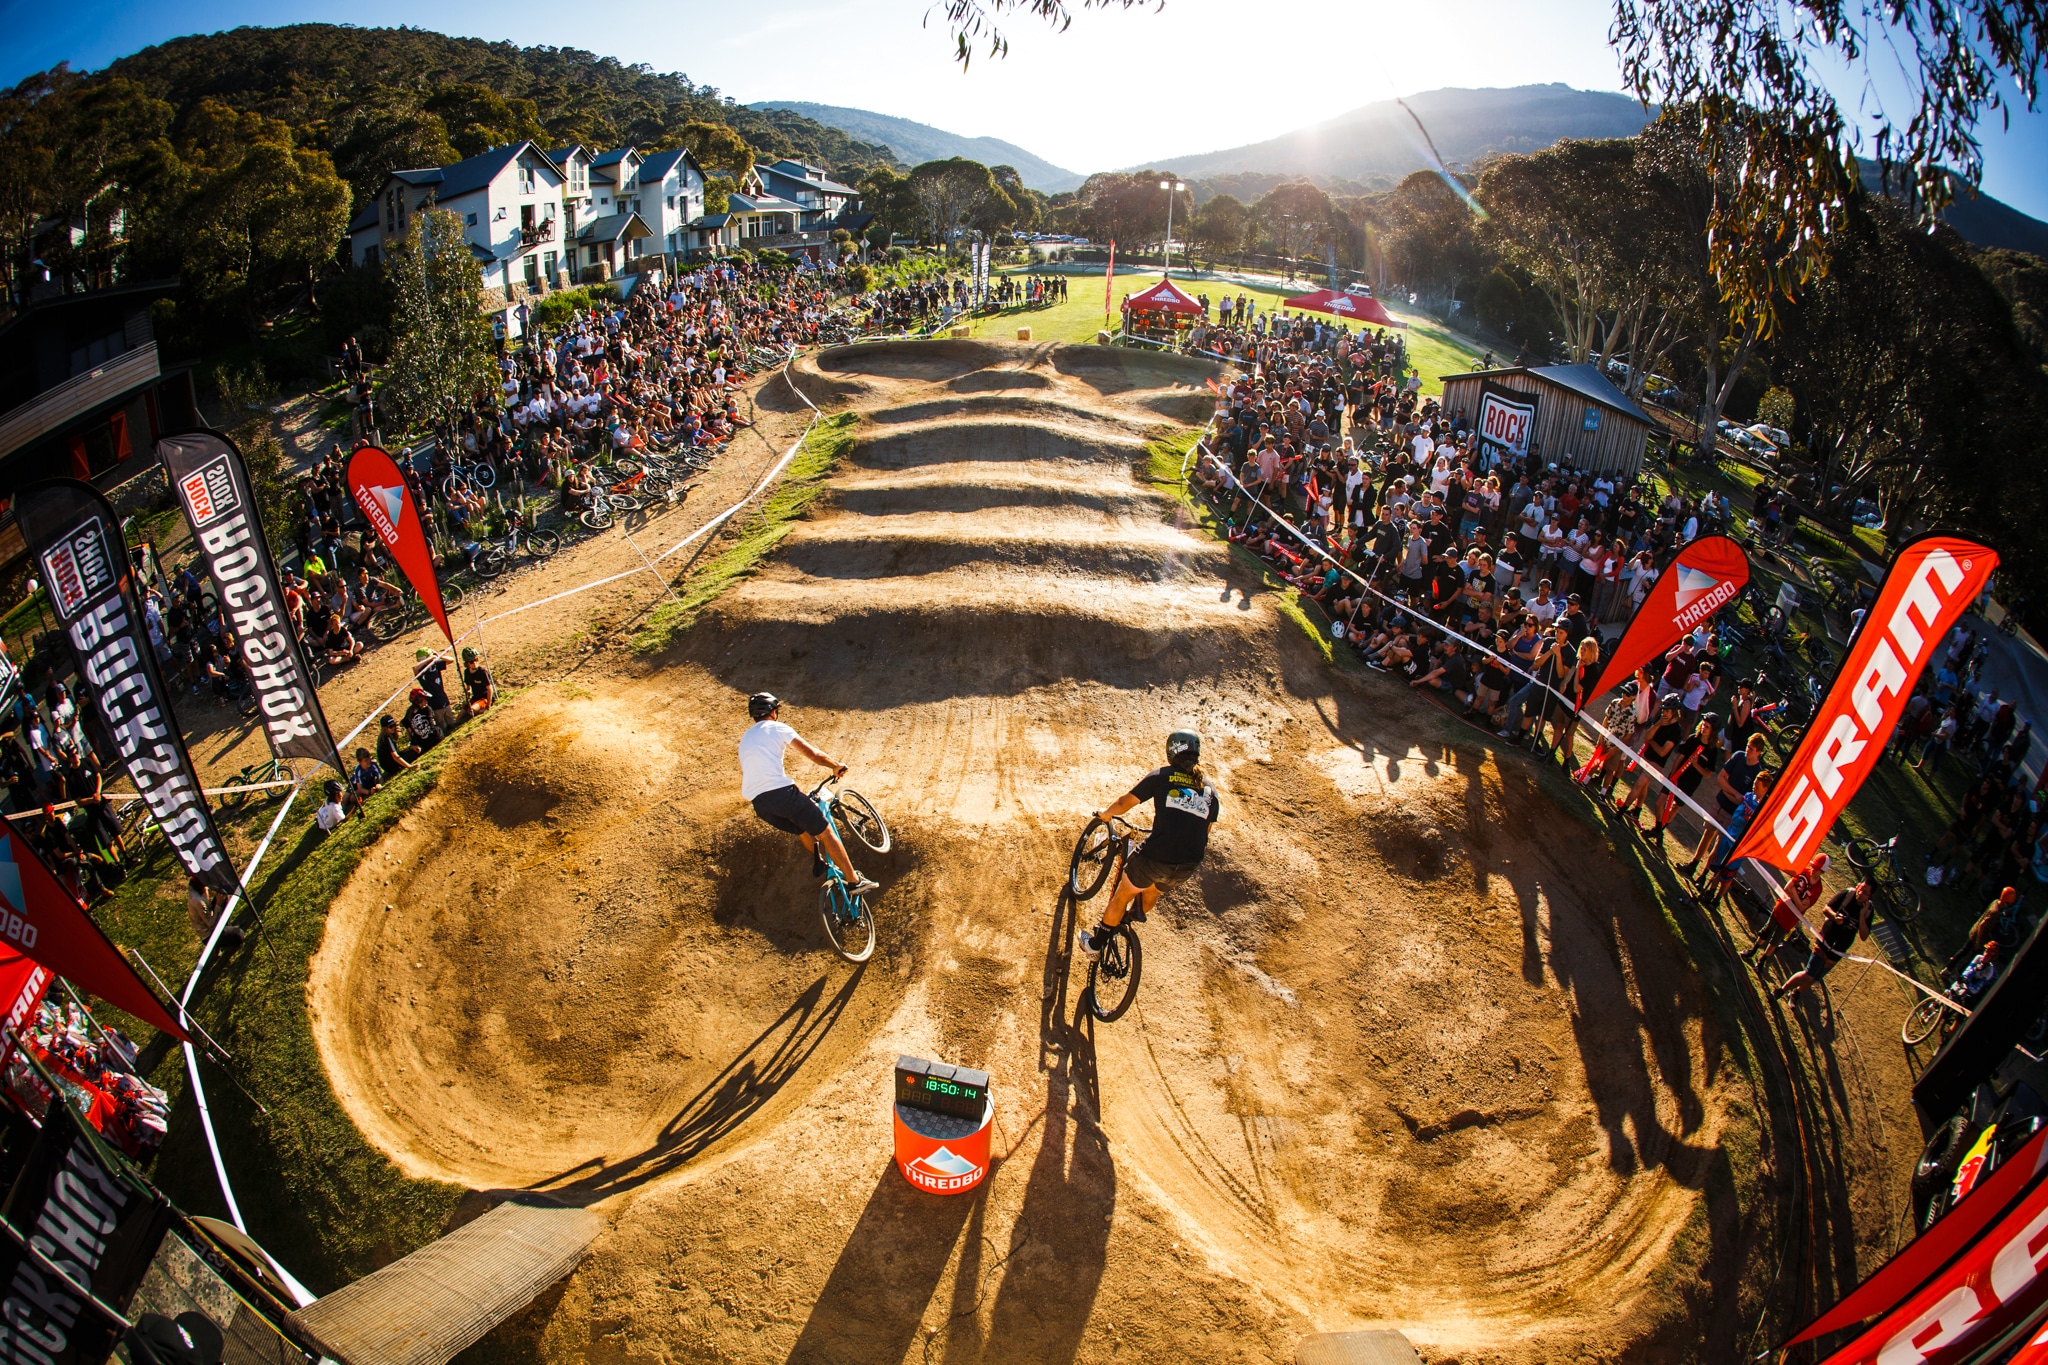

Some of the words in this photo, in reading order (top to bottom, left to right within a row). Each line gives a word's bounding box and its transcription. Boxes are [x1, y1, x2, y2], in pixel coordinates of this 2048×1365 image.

[1151, 296, 1181, 304] THREDBO
[1323, 301, 1357, 313] THREDBO
[1485, 404, 1528, 444] ROCK
[354, 484, 400, 545] THREDBO
[1672, 579, 1738, 632] THREDBO
[1773, 548, 1966, 864] SRAM
[903, 1162, 983, 1190] THREDBO
